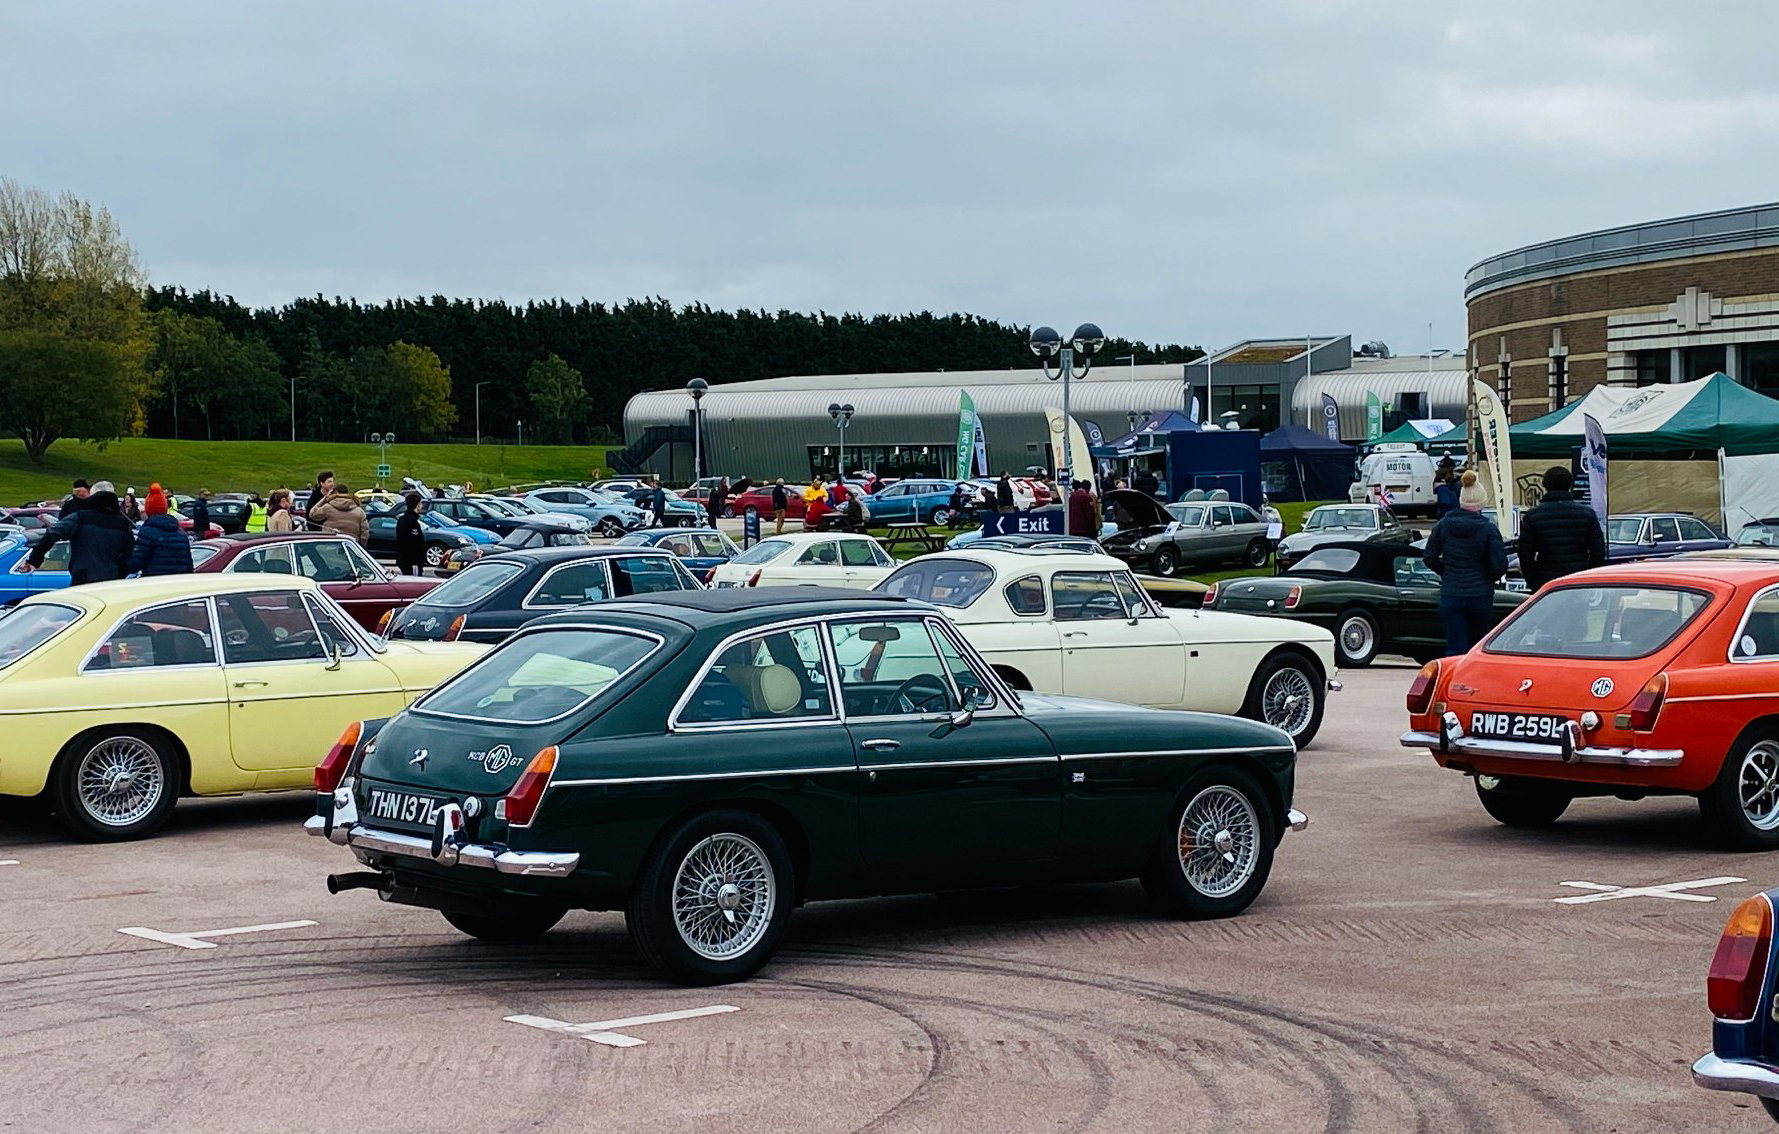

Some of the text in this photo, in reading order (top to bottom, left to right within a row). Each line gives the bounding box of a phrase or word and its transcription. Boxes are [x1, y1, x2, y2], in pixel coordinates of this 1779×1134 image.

[1386, 463, 1411, 471] MOTOR
[1018, 517, 1050, 532] Exit
[1593, 678, 1612, 696] MG
[1471, 713, 1561, 739] RWB 259L
[486, 747, 510, 770] MG
[510, 757, 524, 767] GT
[370, 790, 437, 826] THN 137L
